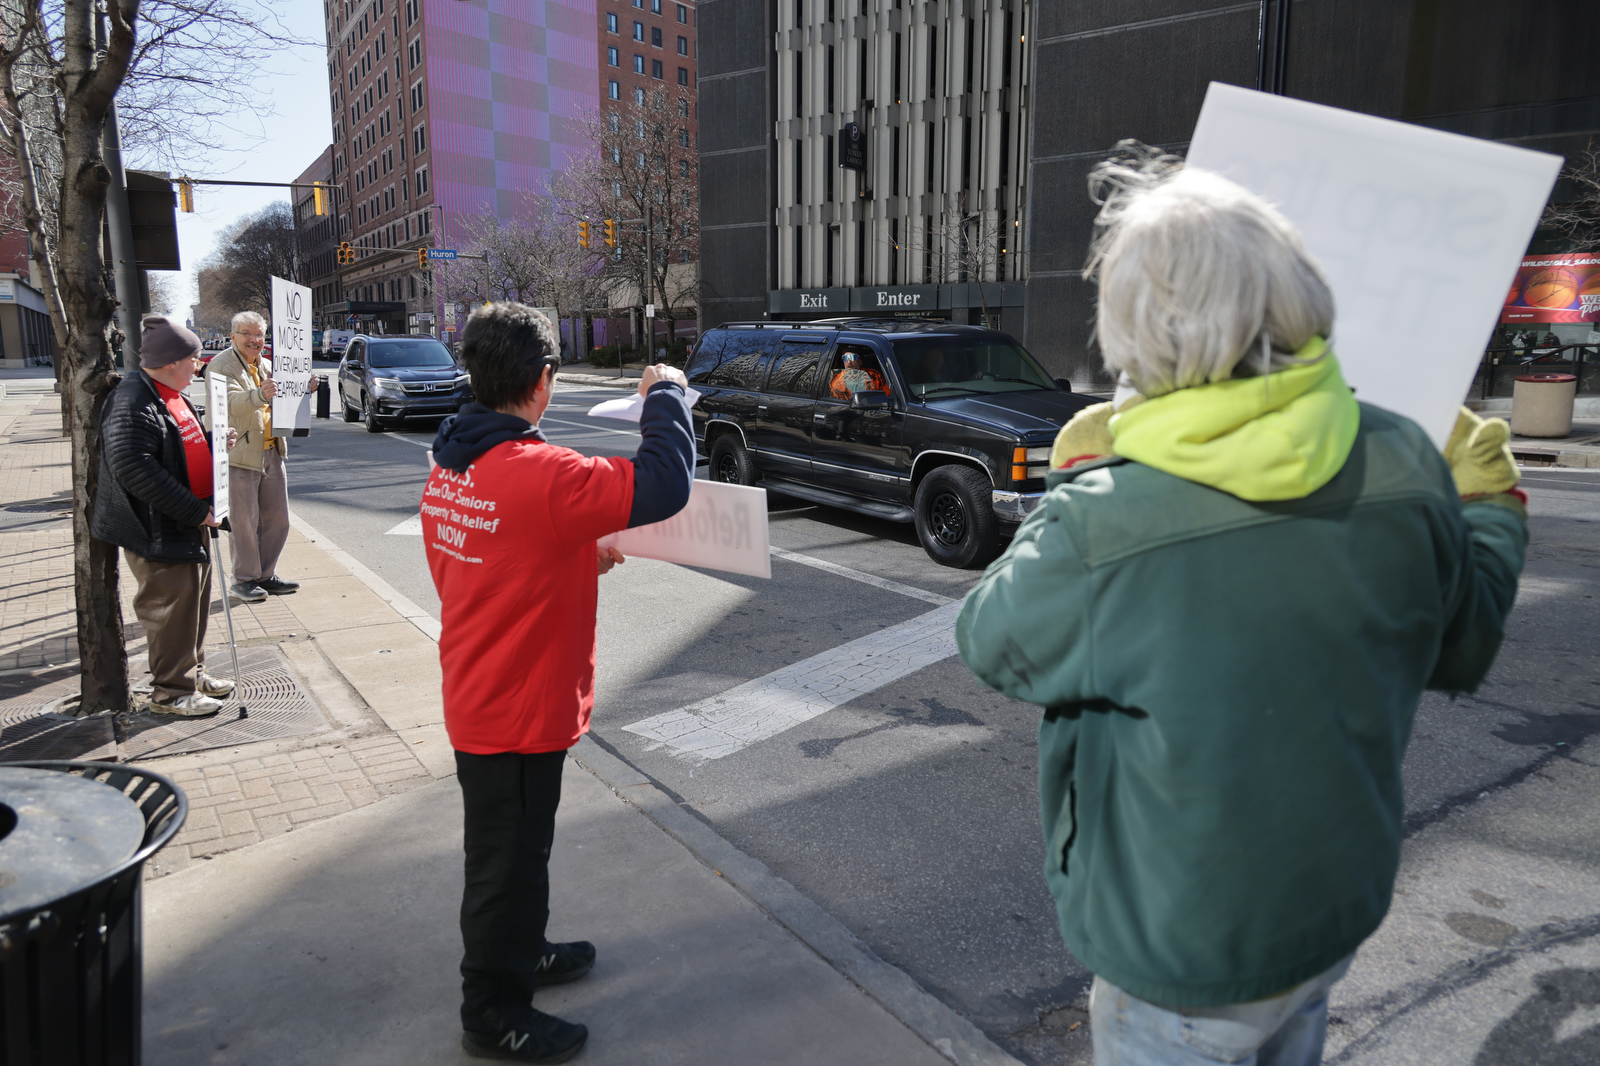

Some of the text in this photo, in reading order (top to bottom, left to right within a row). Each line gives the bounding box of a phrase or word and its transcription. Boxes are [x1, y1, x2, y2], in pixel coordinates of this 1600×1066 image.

[852, 125, 858, 138] P
[430, 250, 455, 258] Huron
[286, 290, 302, 321] NO
[800, 293, 828, 308] Exit
[876, 291, 921, 306] Enter
[278, 325, 304, 351] MORE
[274, 355, 312, 375] OVERVALUED
[425, 481, 497, 512] Save Our Seniors
[421, 502, 501, 534] Property Tax Relief
[437, 523, 467, 549] NOW
